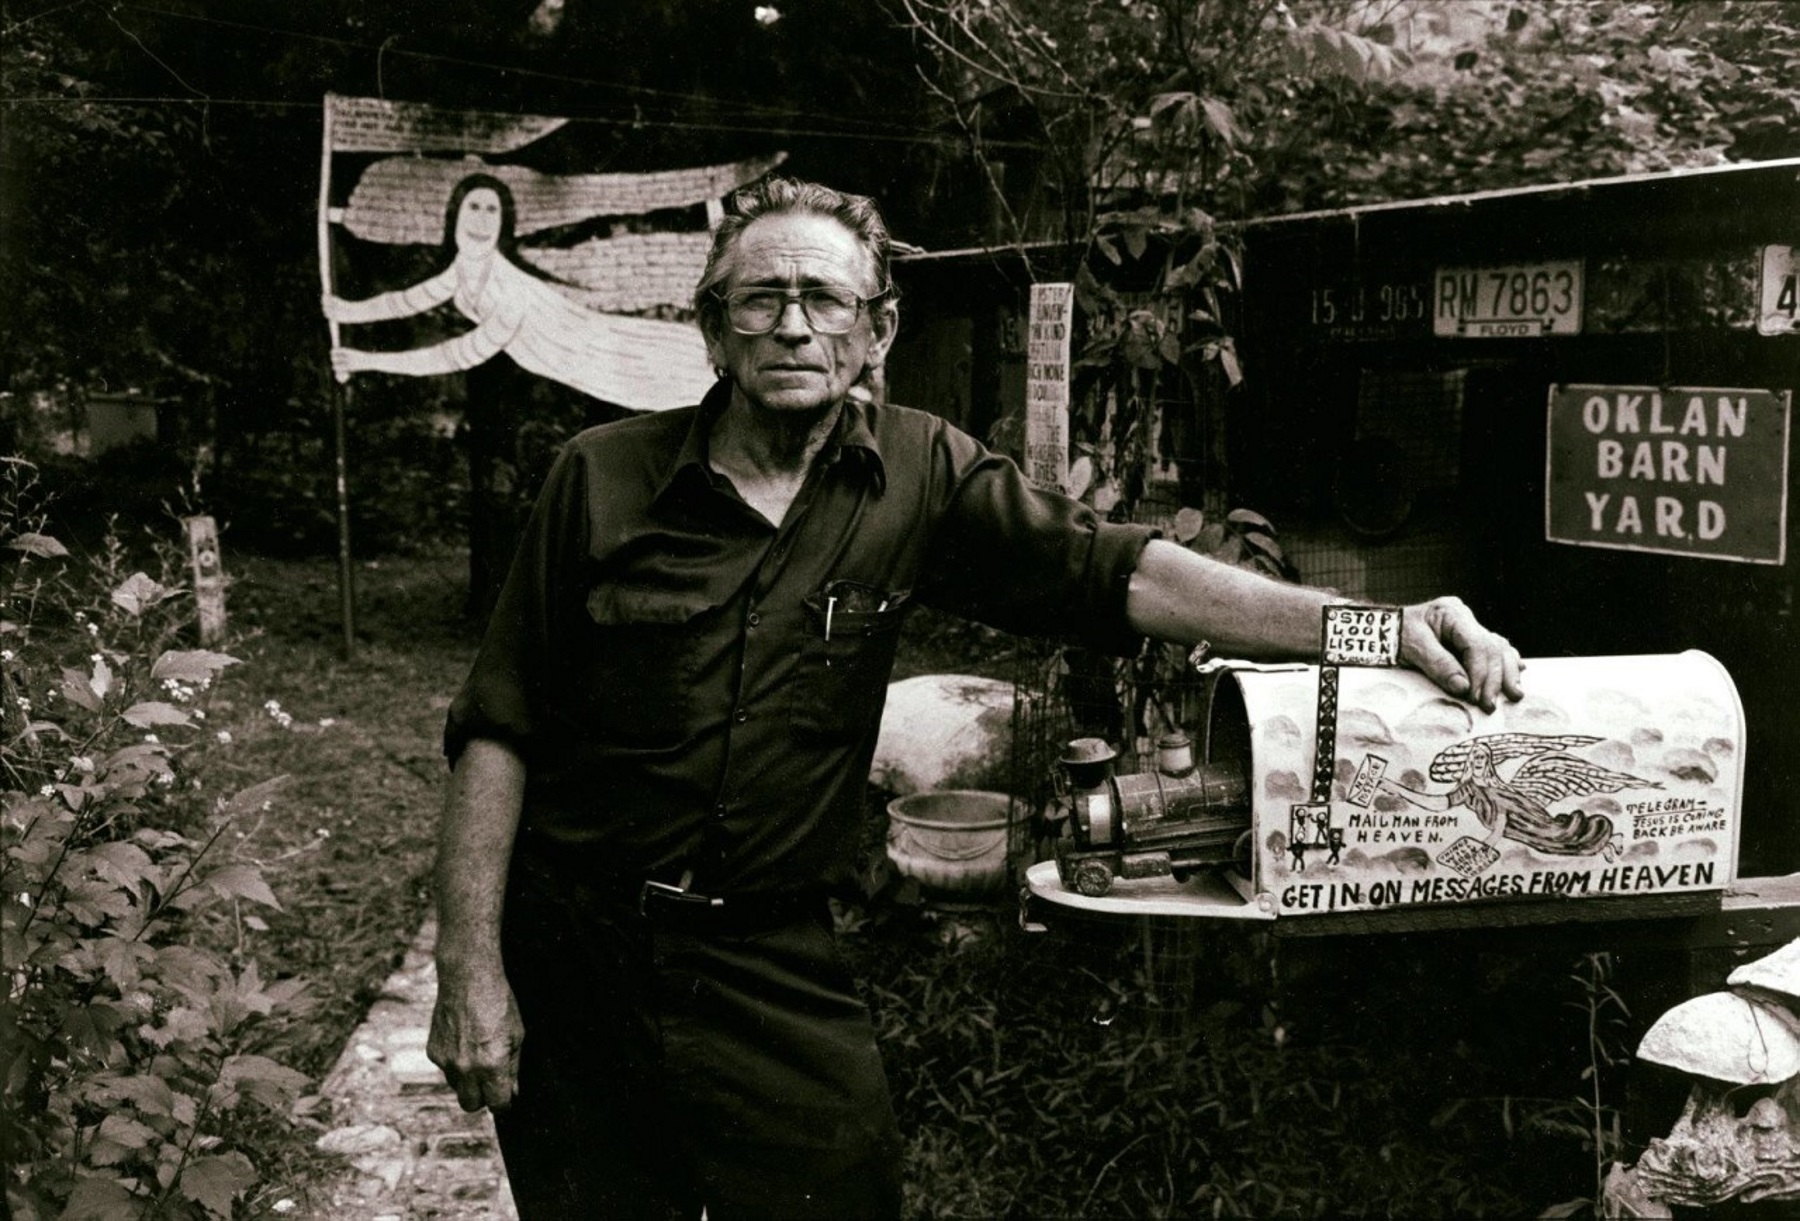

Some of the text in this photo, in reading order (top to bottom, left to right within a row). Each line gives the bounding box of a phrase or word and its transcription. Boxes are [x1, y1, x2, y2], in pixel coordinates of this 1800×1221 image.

[1439, 270, 1574, 318] RM 7863
[1481, 325, 1530, 336] FLOYD
[1583, 393, 1747, 437] OKLAN
[1598, 439, 1726, 485] BARN
[1584, 492, 1726, 540] YARD
[1340, 612, 1391, 626] STOP
[1333, 624, 1391, 642] LOOK
[1329, 637, 1390, 655] LISTEN
[1392, 815, 1420, 828] MAN
[1425, 815, 1458, 828] FROM
[1633, 807, 1725, 828] JESUS IS COMING
[1357, 829, 1444, 843] HEAVEN.
[1633, 819, 1727, 839] BACK BE AWARE
[1282, 861, 1714, 909] GET IN ON MESSAGES FROM HEAVEN
